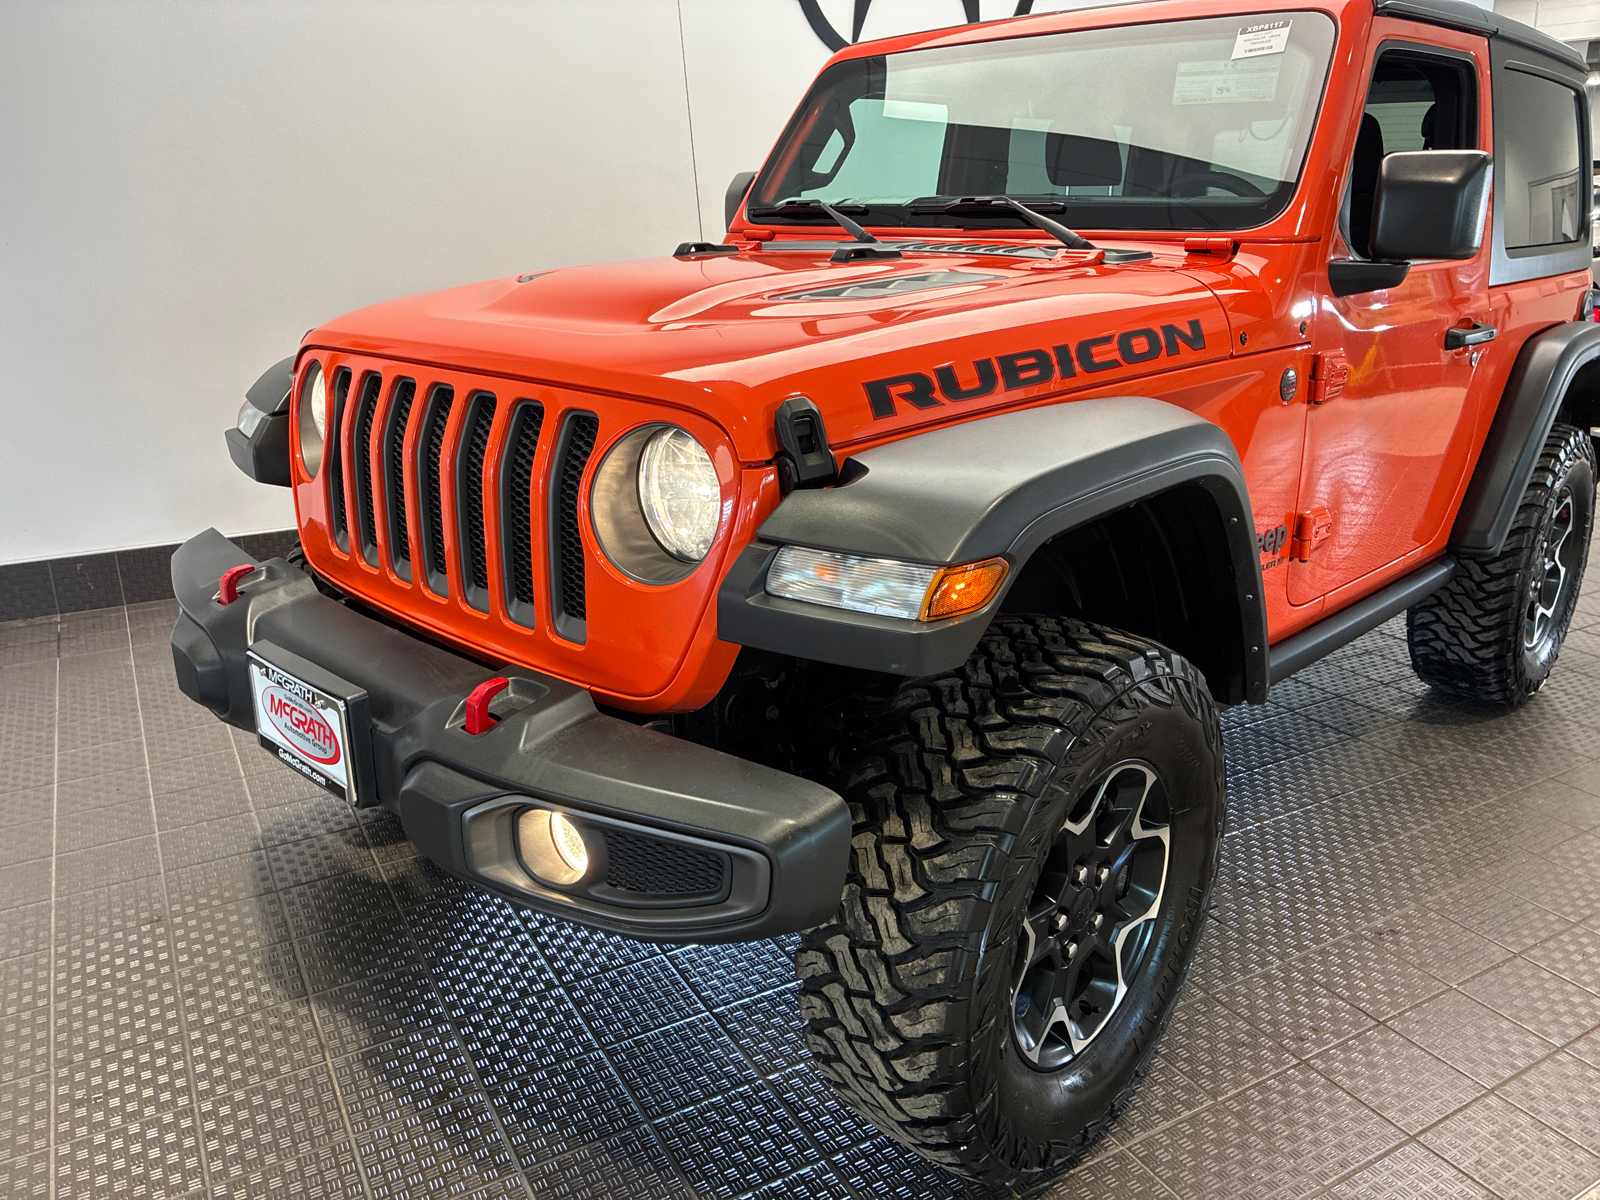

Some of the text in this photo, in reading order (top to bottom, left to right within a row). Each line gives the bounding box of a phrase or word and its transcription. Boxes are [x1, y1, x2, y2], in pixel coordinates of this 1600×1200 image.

[1246, 21, 1284, 33] XBP8117
[861, 318, 1206, 420] RUBICON
[1256, 524, 1287, 555] eep
[284, 722, 328, 755] Automotive Group
[278, 748, 326, 786] GoMcGrath.com
